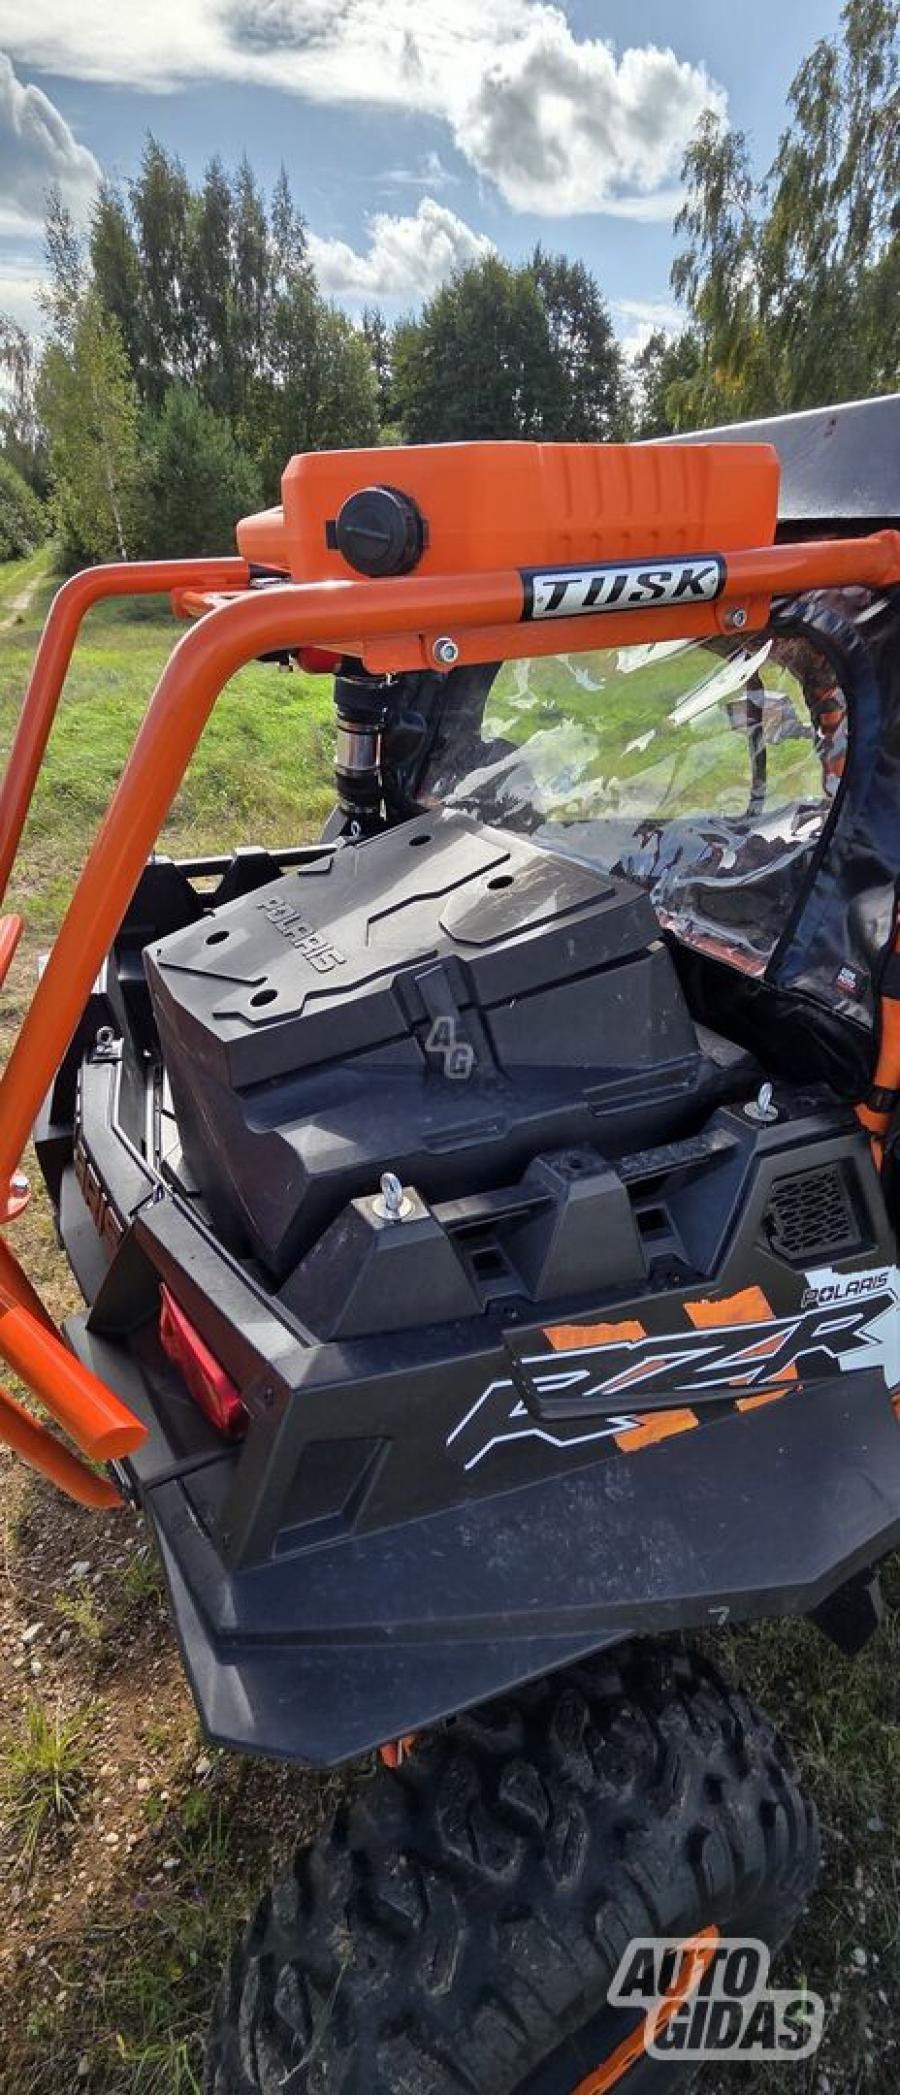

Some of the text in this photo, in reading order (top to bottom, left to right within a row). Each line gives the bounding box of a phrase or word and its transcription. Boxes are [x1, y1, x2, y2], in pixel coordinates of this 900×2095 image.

[542, 567, 715, 612] TUSK
[256, 896, 347, 973] POLARIS
[801, 1272, 889, 1308] POLARIS
[446, 1288, 895, 1470] RZR
